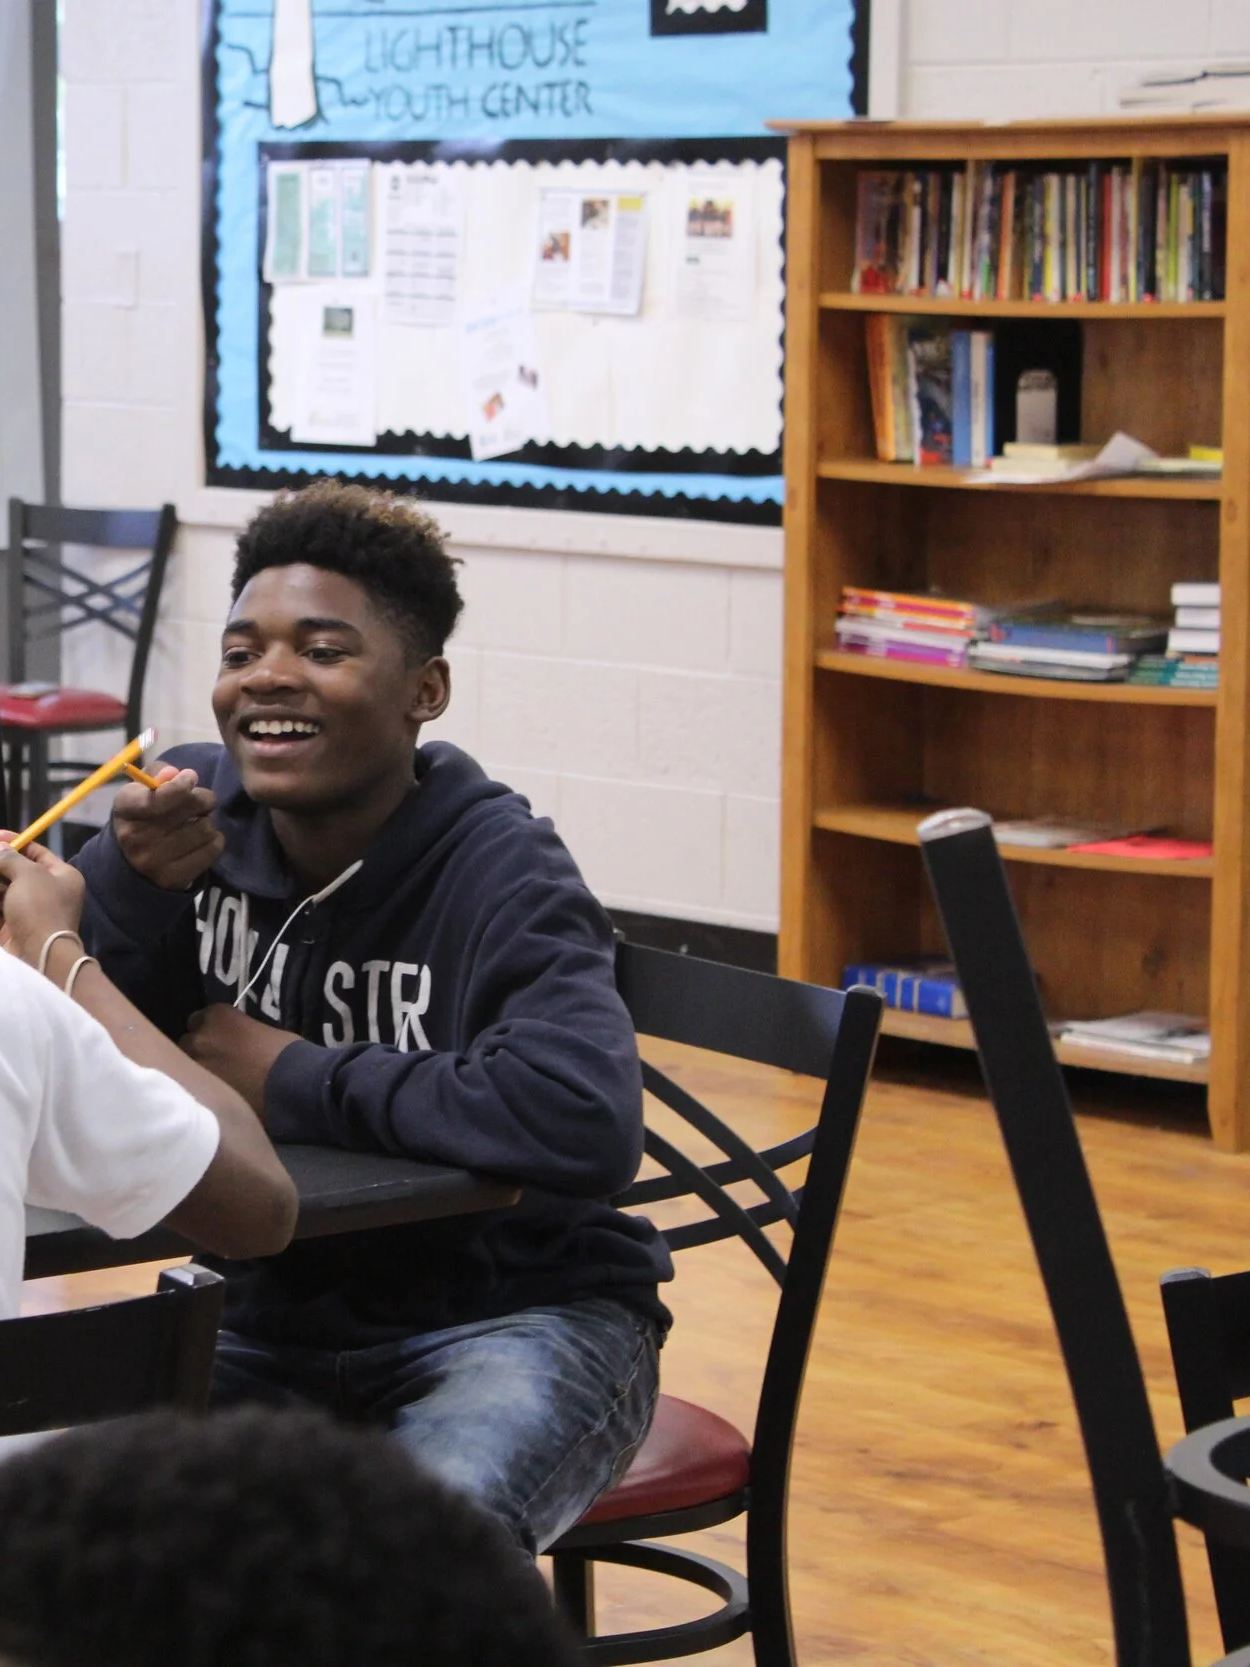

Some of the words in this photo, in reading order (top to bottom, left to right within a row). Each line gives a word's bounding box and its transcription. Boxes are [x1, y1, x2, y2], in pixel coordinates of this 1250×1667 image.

[364, 18, 589, 73] LIGHTHOUSE
[368, 84, 469, 121] YOUTH
[481, 79, 594, 119] CENTER
